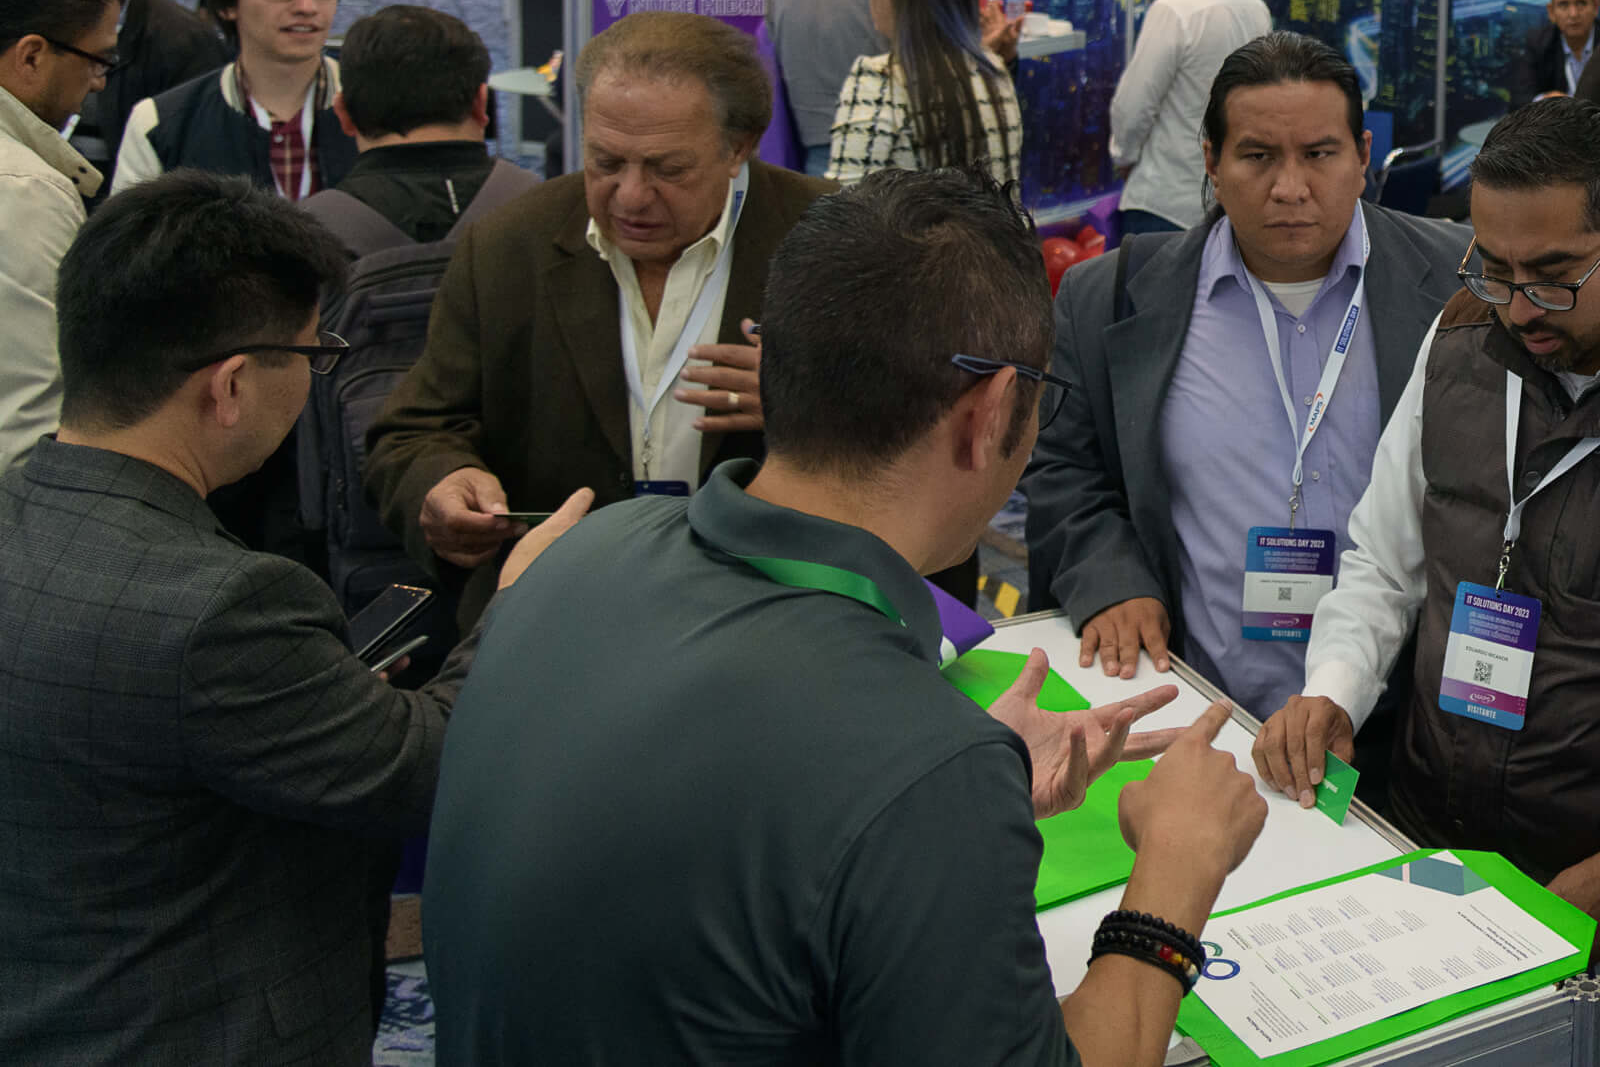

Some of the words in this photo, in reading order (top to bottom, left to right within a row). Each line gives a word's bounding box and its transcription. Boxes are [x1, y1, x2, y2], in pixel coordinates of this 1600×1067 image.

[1266, 538, 1296, 547] SOLUTIONS
[1298, 539, 1309, 548] DAY
[1310, 539, 1325, 548] 2023
[1466, 595, 1472, 604] IT
[1473, 596, 1502, 612] SOLUTIONS
[1503, 603, 1515, 615] DAY
[1514, 607, 1530, 618] 2023
